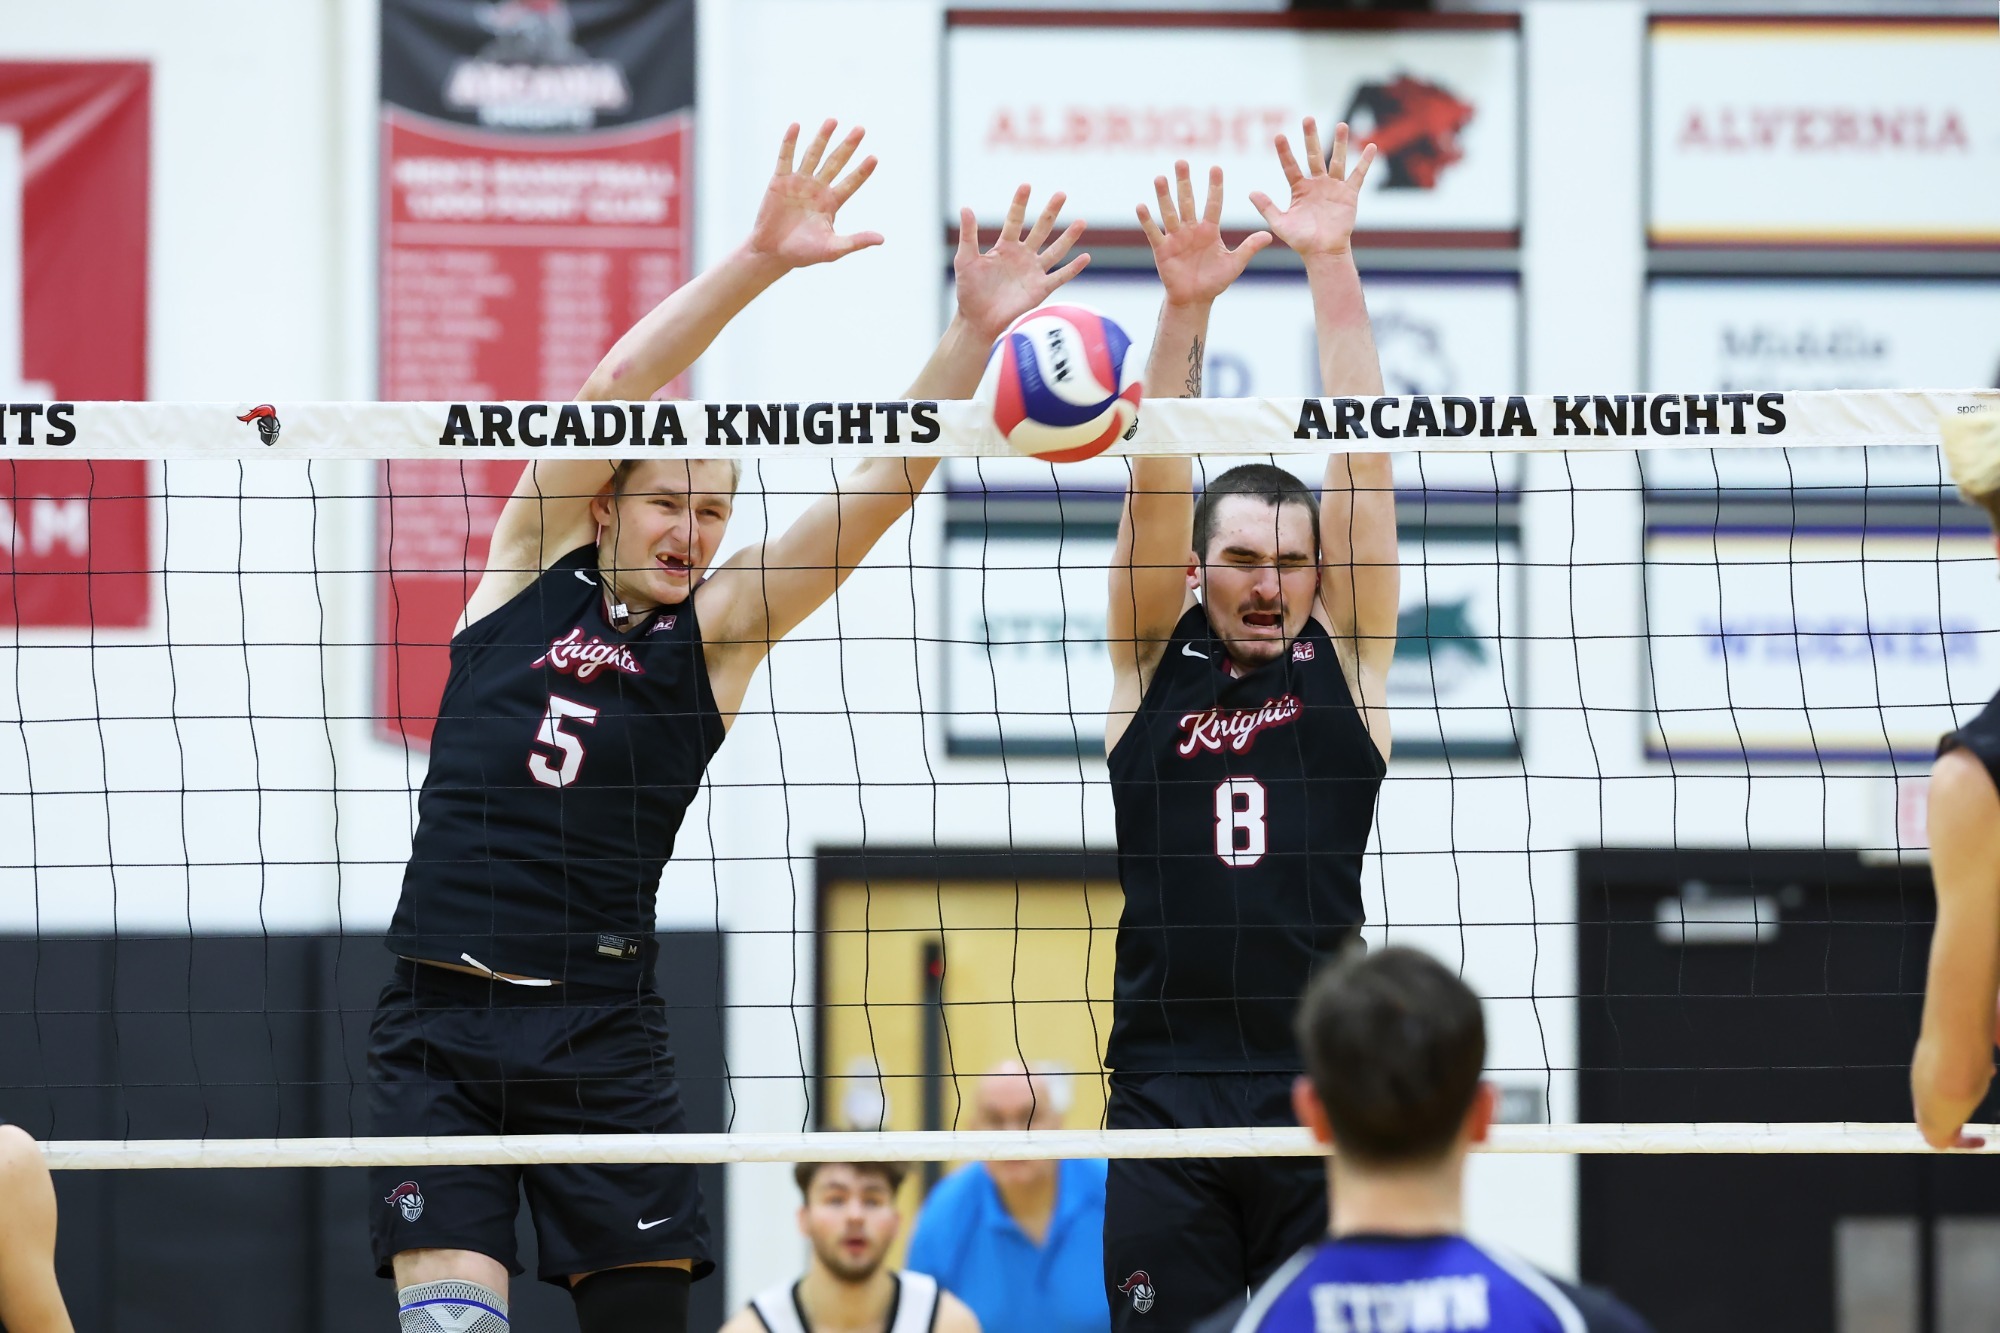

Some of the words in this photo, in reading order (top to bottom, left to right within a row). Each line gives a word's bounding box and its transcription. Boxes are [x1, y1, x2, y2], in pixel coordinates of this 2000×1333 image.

[987, 106, 1290, 151] ALBRIGHT
[1679, 106, 1969, 152] ALVERNIA
[1719, 325, 1889, 361] Middle
[439, 403, 688, 447] ARCADIA
[704, 402, 942, 445] KNIGHTS
[1293, 396, 1537, 439] ARCADIA
[1553, 392, 1788, 436] KNIGHTS
[531, 627, 642, 680] Knights
[1699, 616, 1979, 664] WIDENER
[526, 692, 600, 789] 5
[1179, 694, 1300, 756] Knights
[1213, 775, 1268, 868] 8
[628, 944, 638, 955] M
